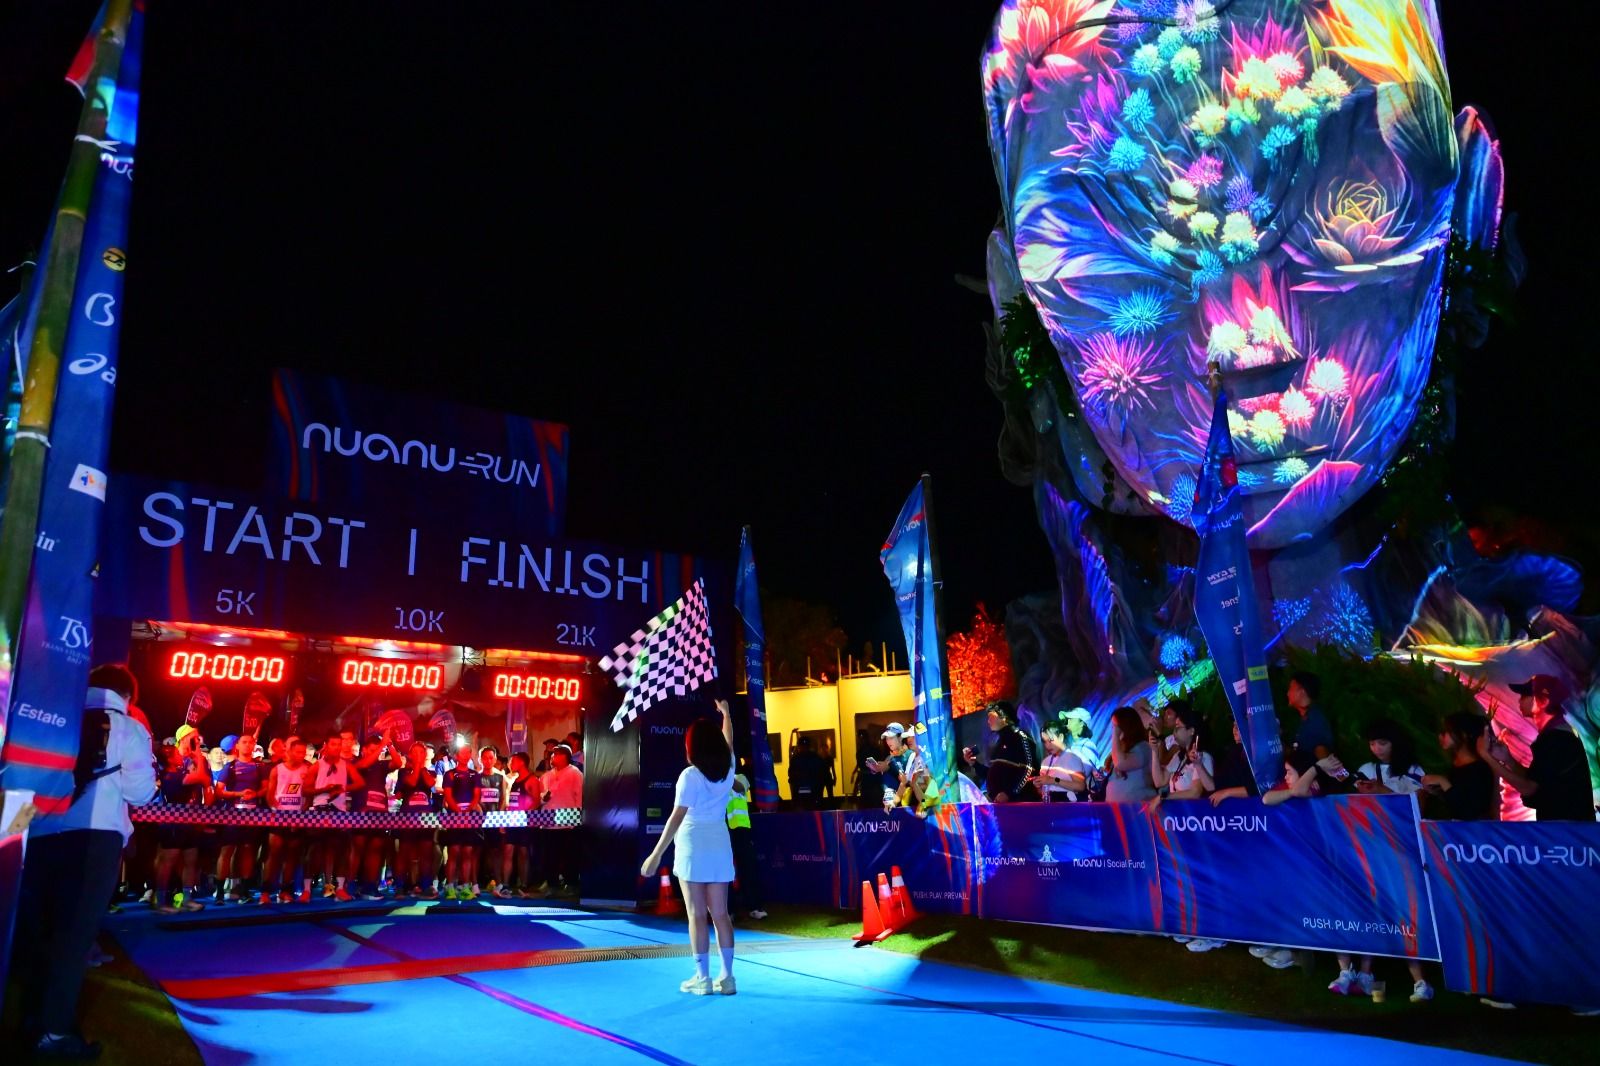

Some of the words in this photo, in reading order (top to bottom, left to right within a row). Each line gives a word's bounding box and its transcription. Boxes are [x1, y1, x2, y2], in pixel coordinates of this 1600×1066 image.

[459, 451, 541, 488] RUN
[138, 491, 366, 569] START
[460, 536, 649, 604] FINISH
[215, 589, 255, 616] 5K
[394, 606, 444, 633] 10K
[556, 623, 596, 647] 21K
[169, 651, 285, 683] 00:00:00
[494, 673, 580, 701] 00:00:00
[18, 703, 67, 728] Estate
[1228, 815, 1268, 832] RUN
[1037, 867, 1060, 877] LUNA
[1107, 858, 1127, 868] Social
[1128, 859, 1145, 869] Fund
